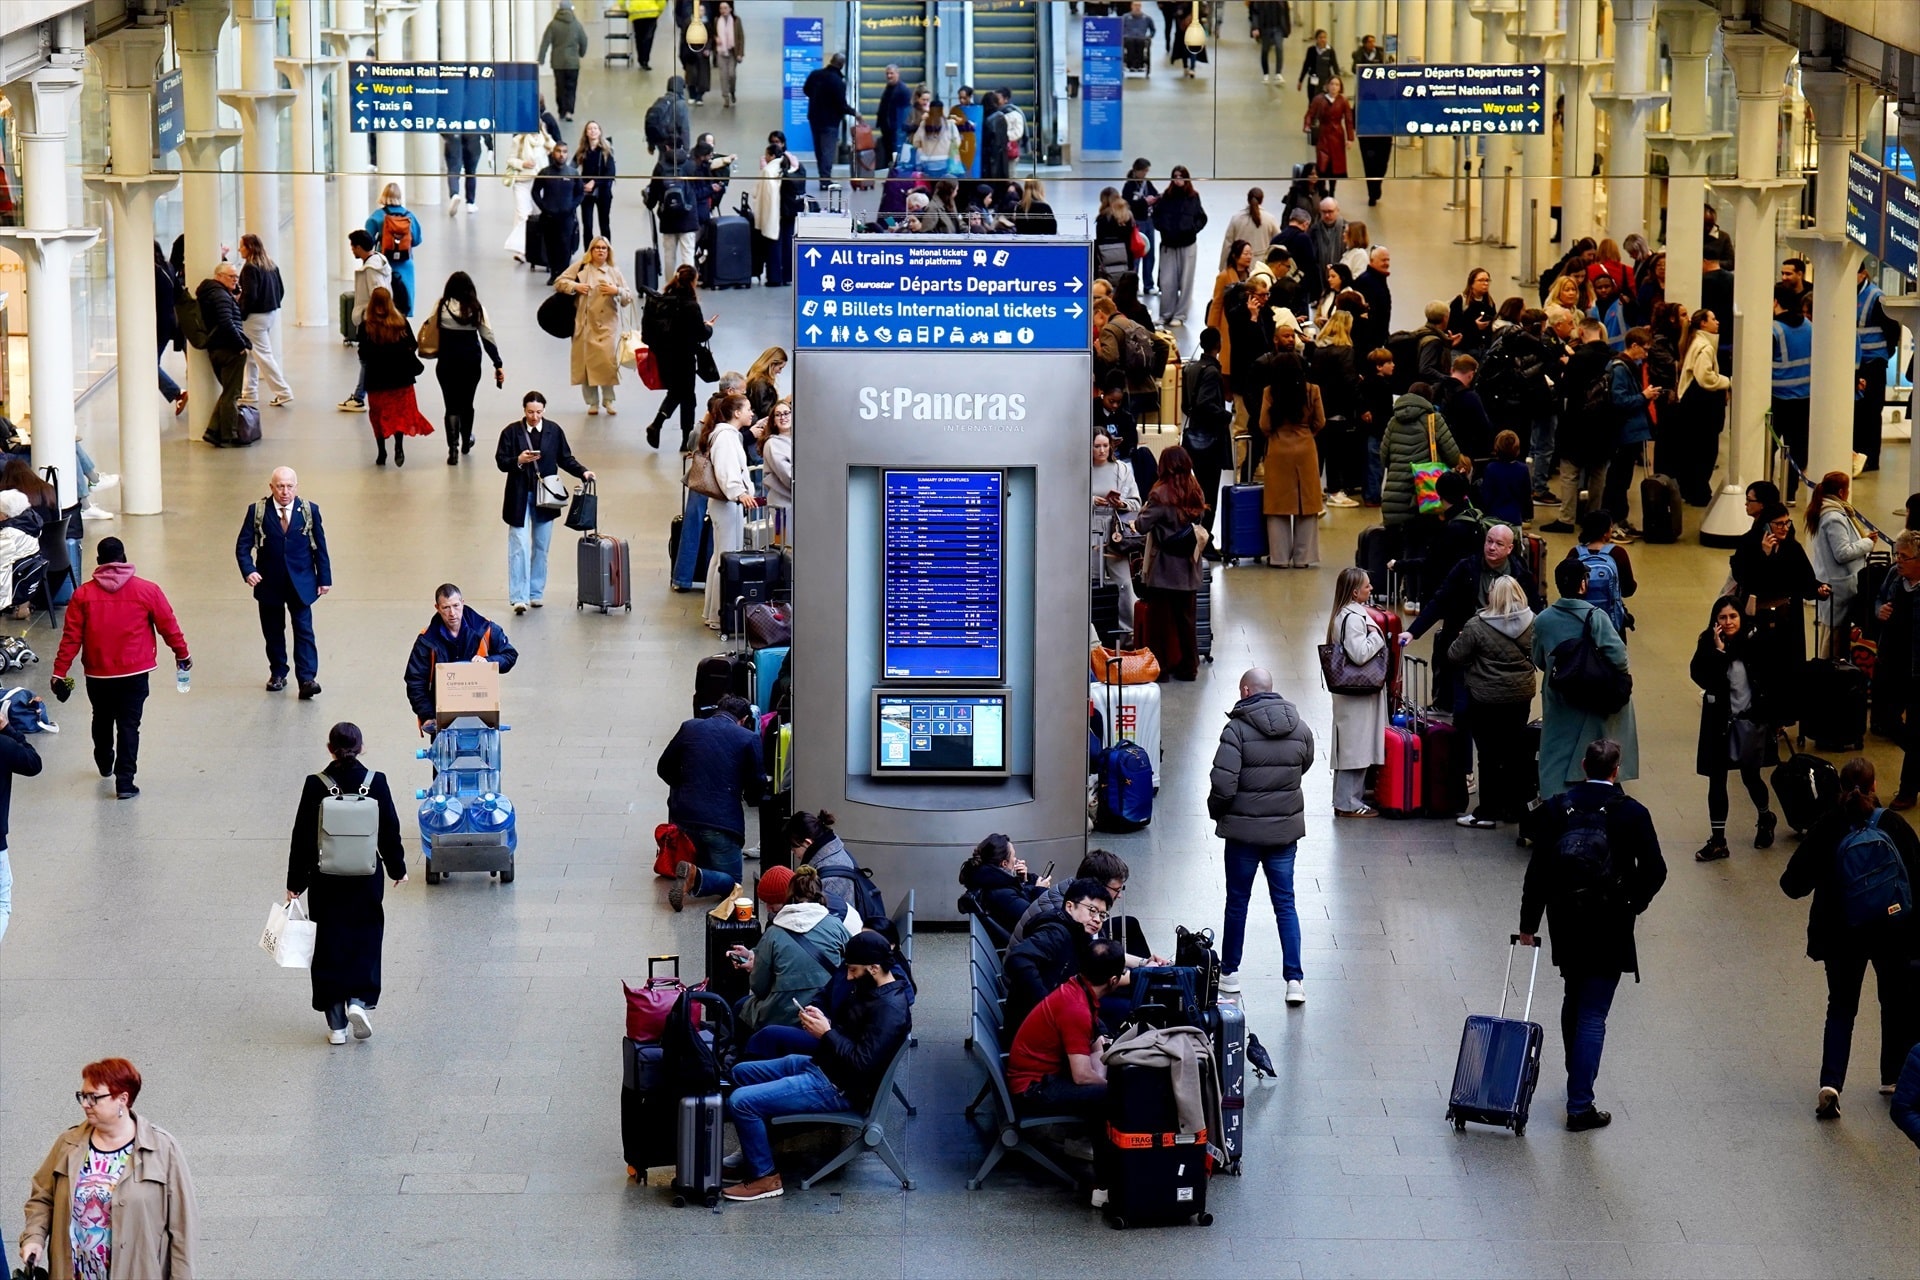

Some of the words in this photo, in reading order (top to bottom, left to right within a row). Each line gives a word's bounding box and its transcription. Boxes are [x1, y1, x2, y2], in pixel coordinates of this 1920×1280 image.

[372, 66, 415, 77] National
[416, 66, 437, 77] Rail
[1425, 67, 1464, 79] Départs
[1467, 67, 1524, 79] Departures
[373, 84, 395, 96] Way
[397, 85, 413, 94] out
[1459, 85, 1501, 96] National
[1503, 85, 1523, 96] Rail
[373, 101, 400, 111] Taxis
[1483, 103, 1504, 115] Way
[1507, 104, 1524, 113] out
[830, 250, 853, 265] All
[857, 250, 904, 265] trains
[909, 249, 942, 257] National
[943, 249, 968, 257] tickets
[909, 257, 924, 265] and
[925, 257, 962, 267] platforms
[855, 280, 895, 289] eurostar
[900, 276, 962, 294] Départs
[967, 277, 1056, 294] Departures
[842, 301, 893, 317] Billets
[898, 302, 999, 317] International
[1003, 302, 1056, 317] tickets
[1115, 705, 1136, 746] FREE
